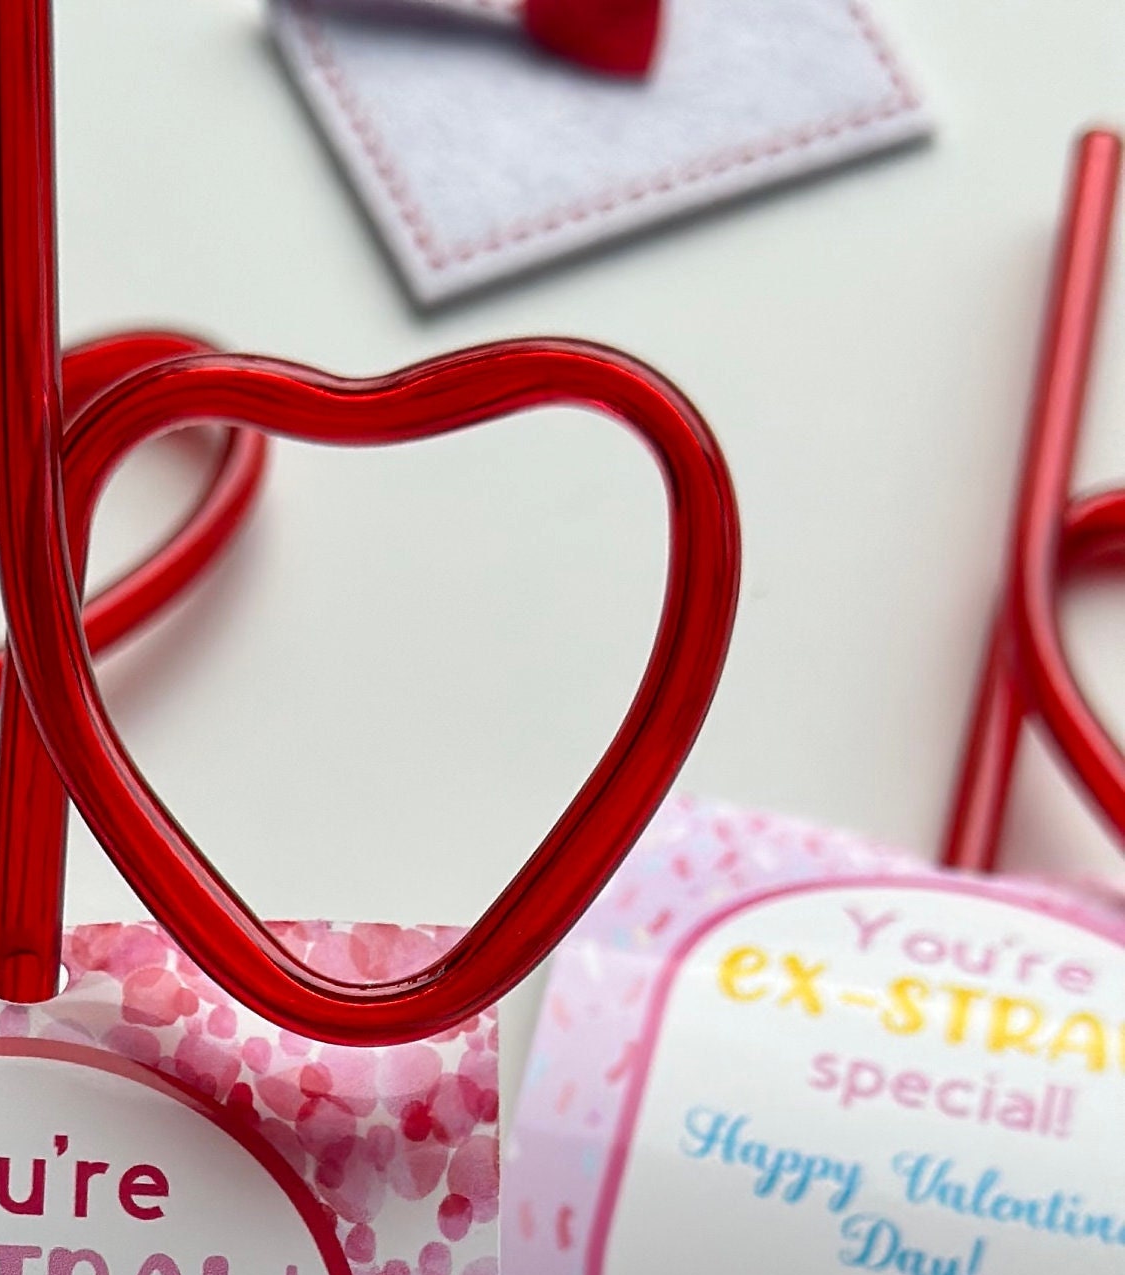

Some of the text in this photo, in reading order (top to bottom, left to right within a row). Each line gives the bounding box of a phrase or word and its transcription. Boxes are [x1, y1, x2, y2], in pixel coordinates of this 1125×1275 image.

[845, 906, 1096, 994] You're
[717, 947, 1125, 1072] ex-STRA
[809, 1051, 1075, 1139] special!
[681, 1106, 1125, 1245] Happy Valentin
